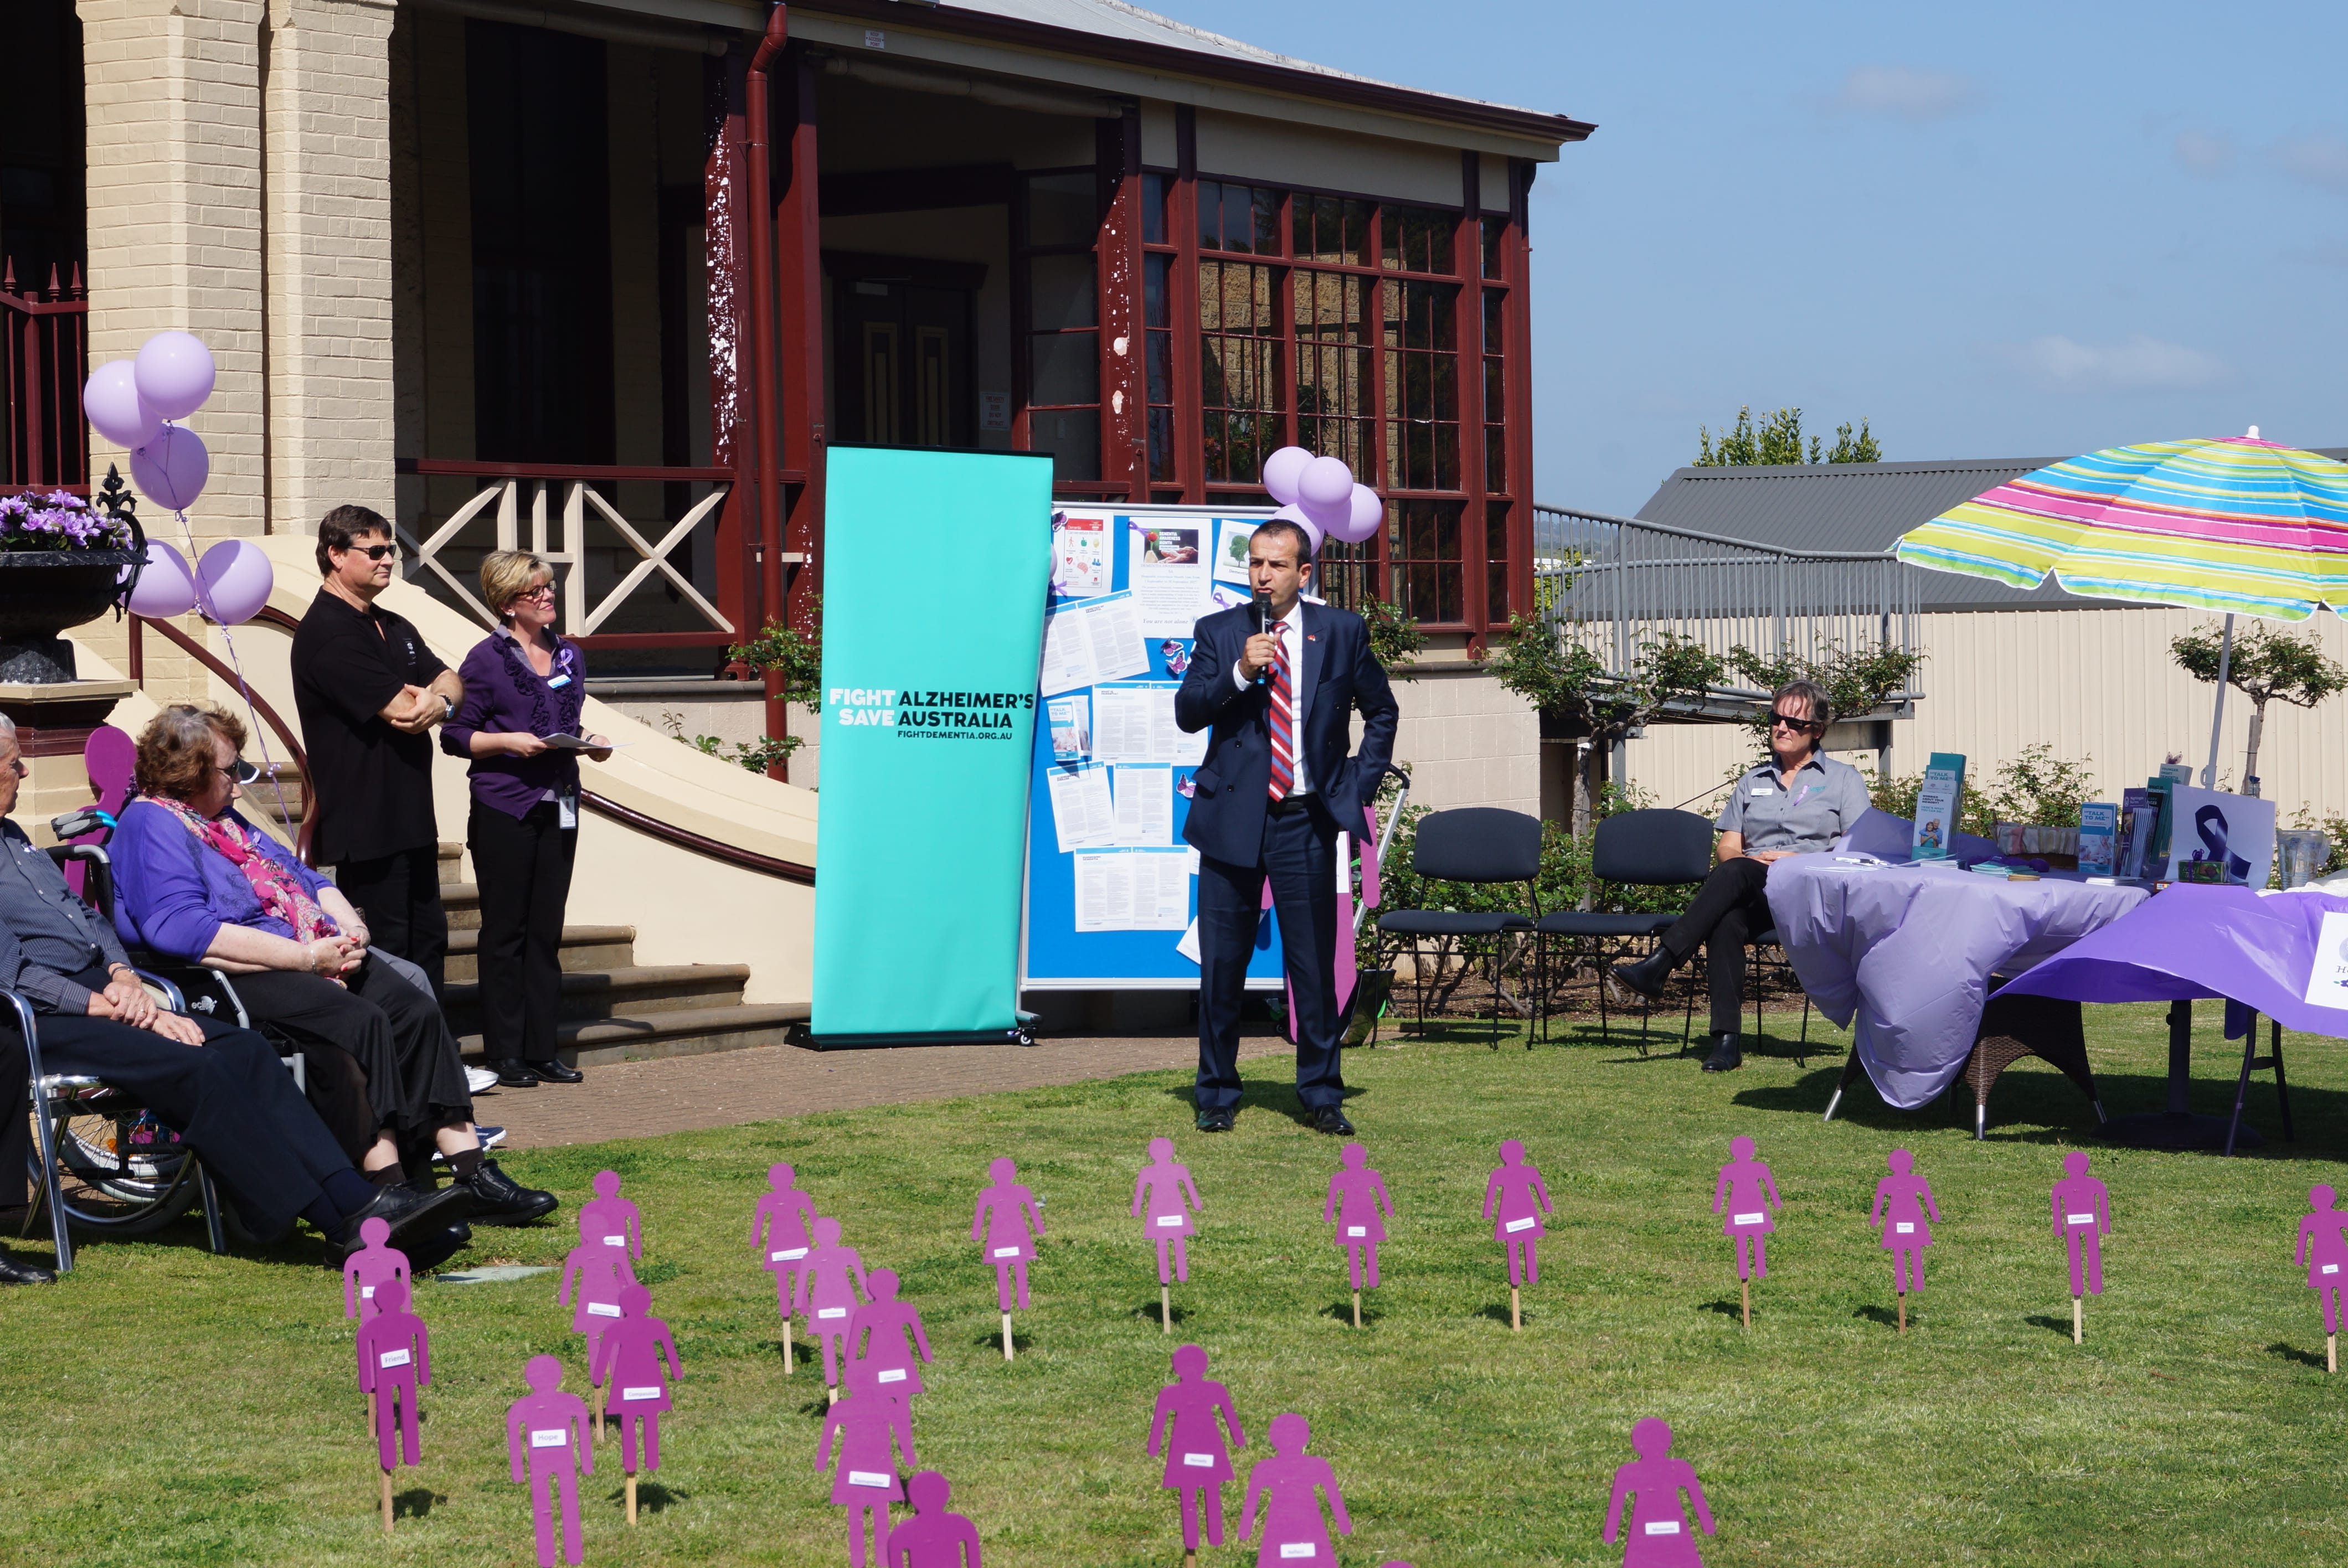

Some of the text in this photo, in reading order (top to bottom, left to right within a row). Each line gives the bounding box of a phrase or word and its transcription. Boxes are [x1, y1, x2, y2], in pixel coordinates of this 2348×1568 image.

[830, 688, 1033, 709] FIGHT ALZHEIMER'S
[839, 709, 1013, 728] SAVE AUSTRALIA
[898, 730, 1012, 740] FIGHTDEMENTIA.ORG.AU
[384, 1354, 405, 1364] Friend
